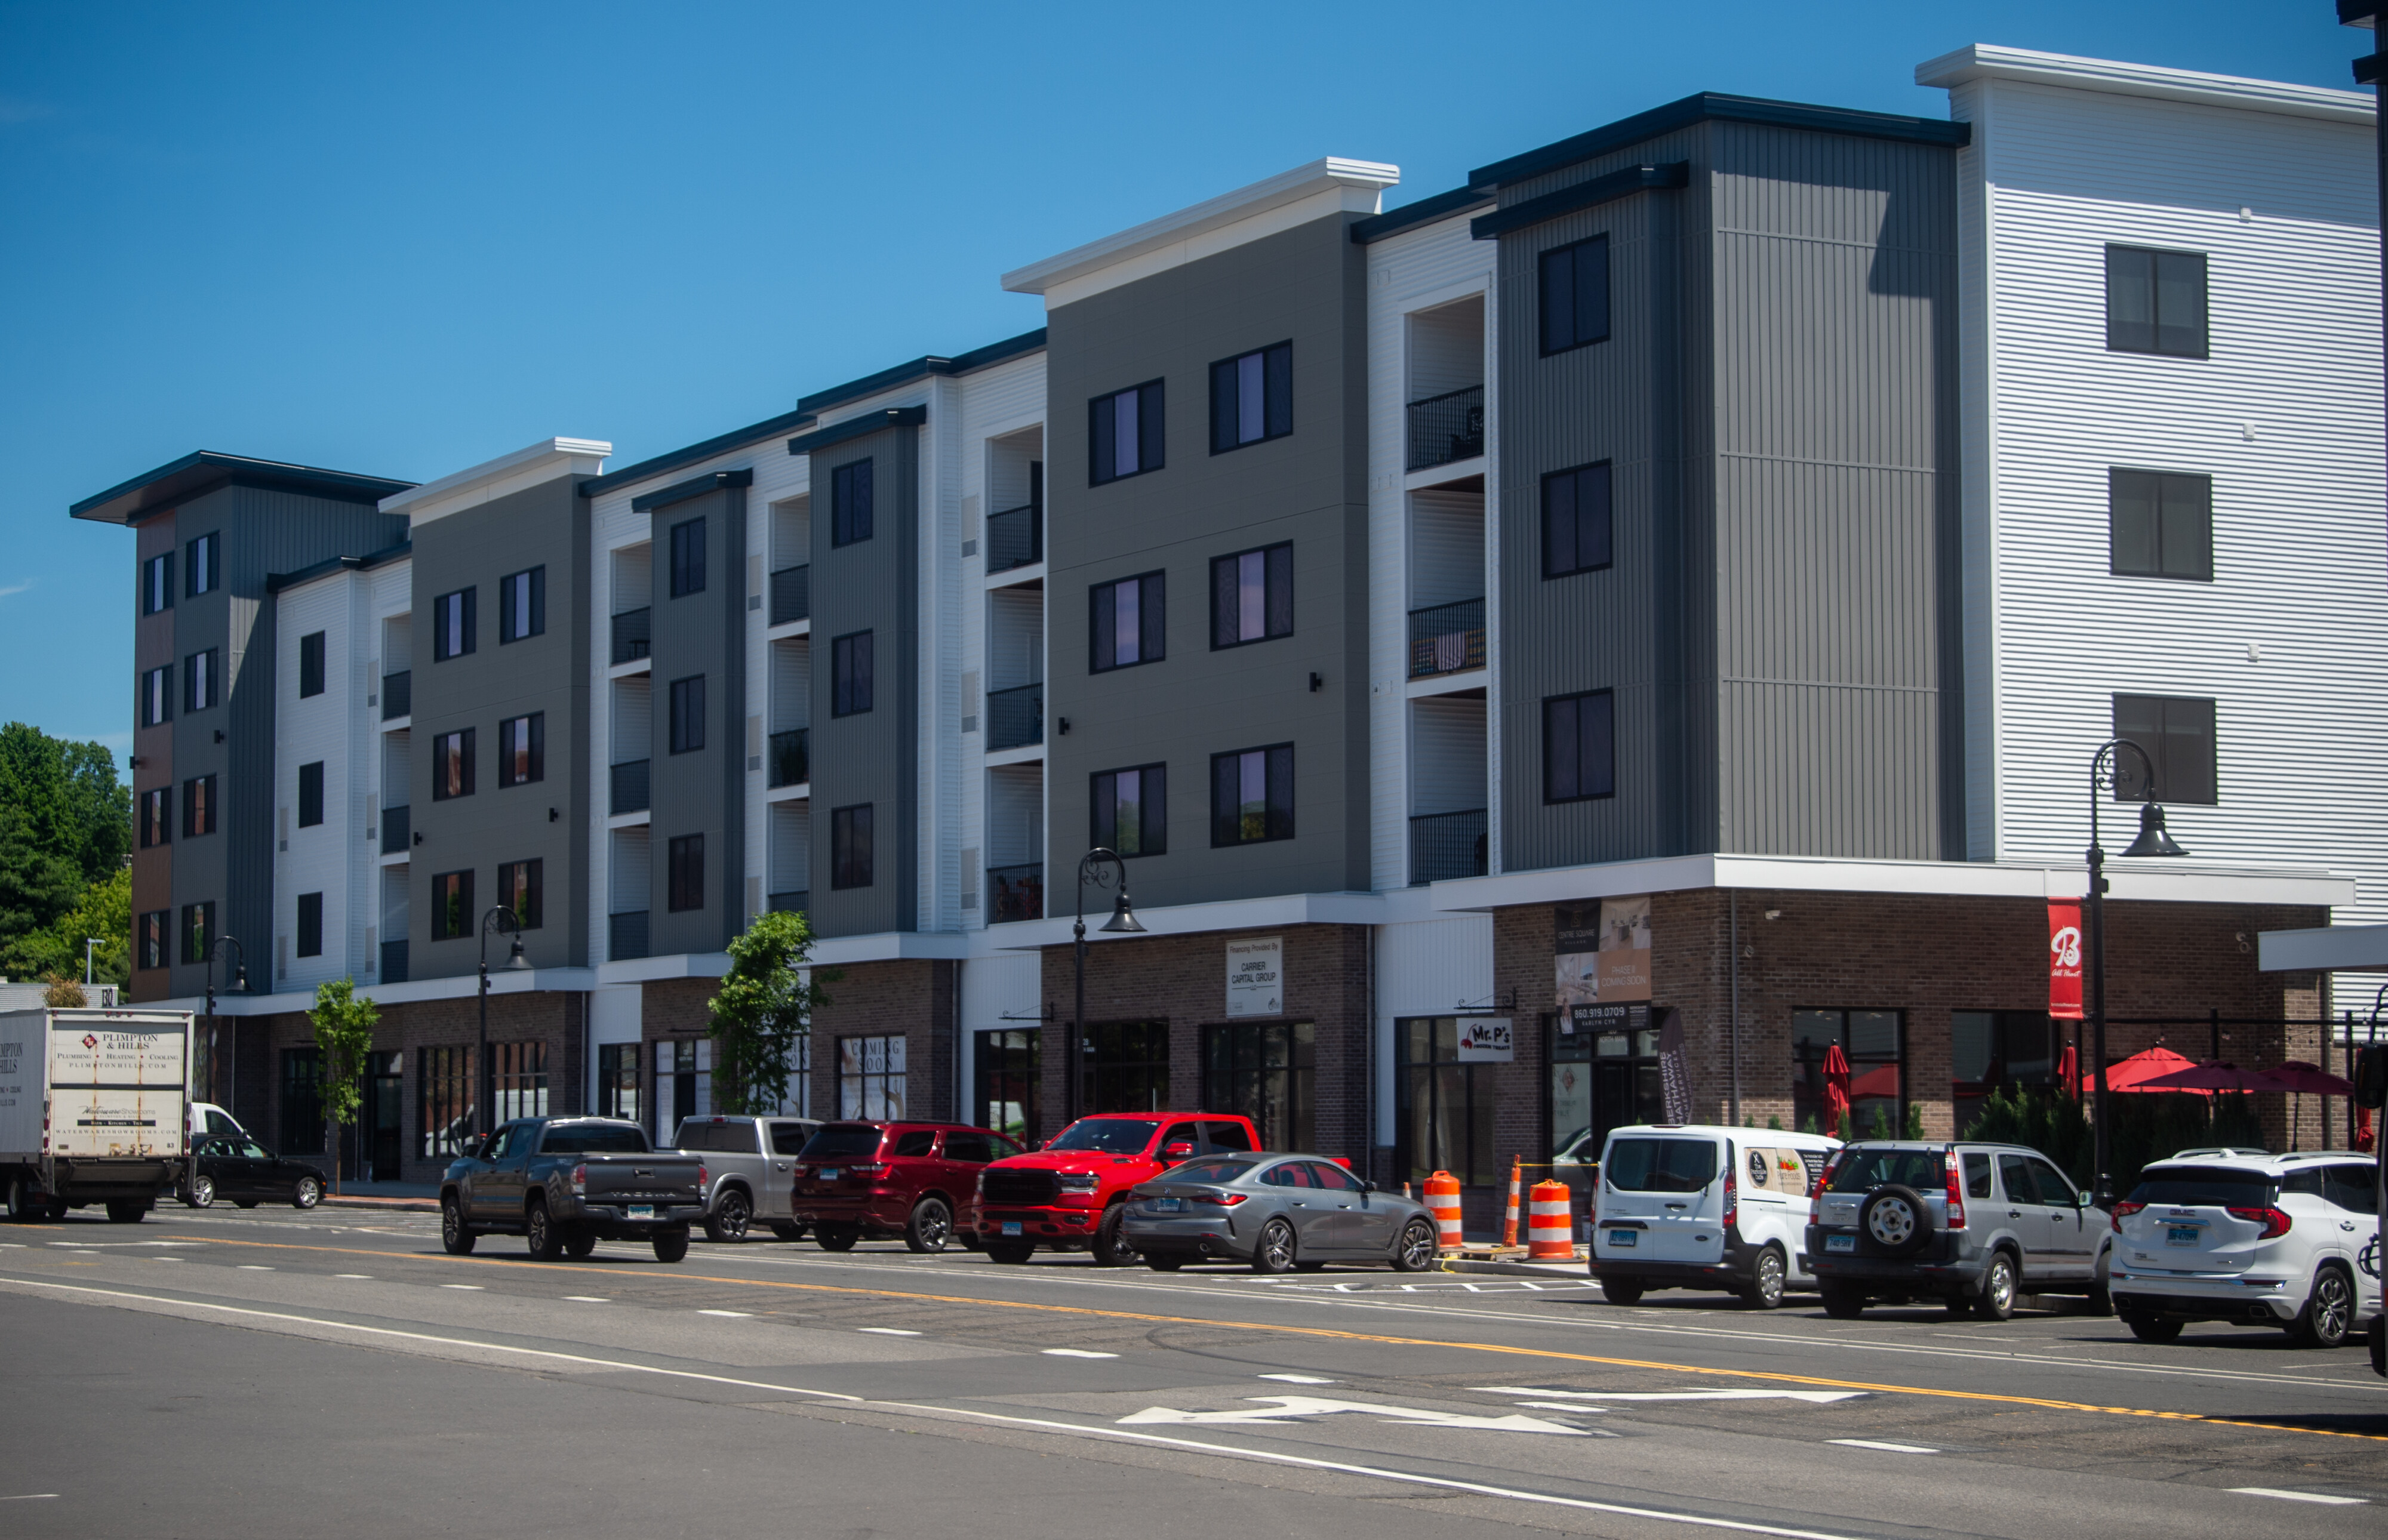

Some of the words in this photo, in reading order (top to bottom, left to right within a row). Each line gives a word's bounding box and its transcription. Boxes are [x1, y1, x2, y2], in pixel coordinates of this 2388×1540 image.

[1558, 931, 1574, 939] CENTRE
[1575, 929, 1595, 938] SQUARE
[1272, 943, 1278, 951] By
[1241, 961, 1266, 972] CARRIER
[1612, 965, 1630, 975] PHASE
[2051, 968, 2061, 977] All
[2063, 968, 2081, 977] Heart
[1232, 974, 1254, 984] CAPITAL
[1255, 972, 1276, 982] GROUP
[1601, 977, 1626, 987] COMING
[1627, 975, 1645, 985] SOON
[1574, 1007, 1624, 1019] 860.919.0709
[1472, 1025, 1491, 1042] Mr.
[1494, 1026, 1510, 1043] P's
[0, 1042, 23, 1057] MPTON
[852, 1040, 899, 1056] COMING
[858, 1057, 893, 1071] SOON
[1660, 1052, 1675, 1125] BERKSHIRE
[1666, 1052, 1684, 1125] HATHAWAY
[1672, 1051, 1690, 1118] OMESERVICES
